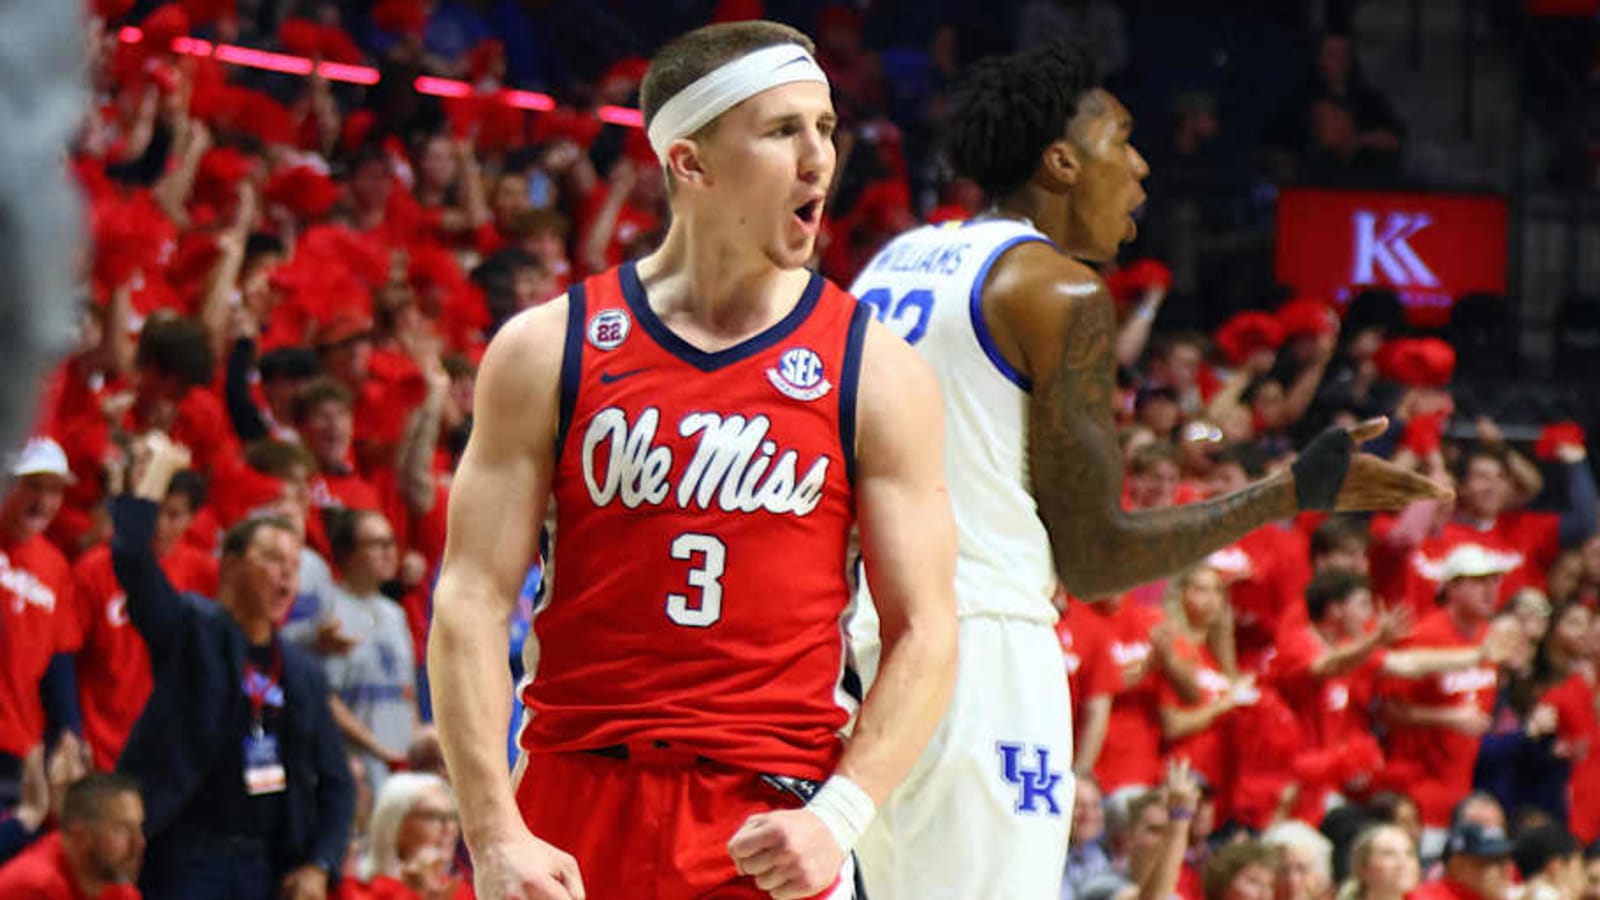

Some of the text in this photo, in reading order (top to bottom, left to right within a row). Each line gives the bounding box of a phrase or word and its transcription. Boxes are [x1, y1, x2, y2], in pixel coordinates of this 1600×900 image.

[596, 322, 623, 343] 22
[781, 347, 823, 387] SEC
[582, 406, 830, 517] Ole Miss
[665, 532, 727, 628] 3
[998, 741, 1063, 815] UK
